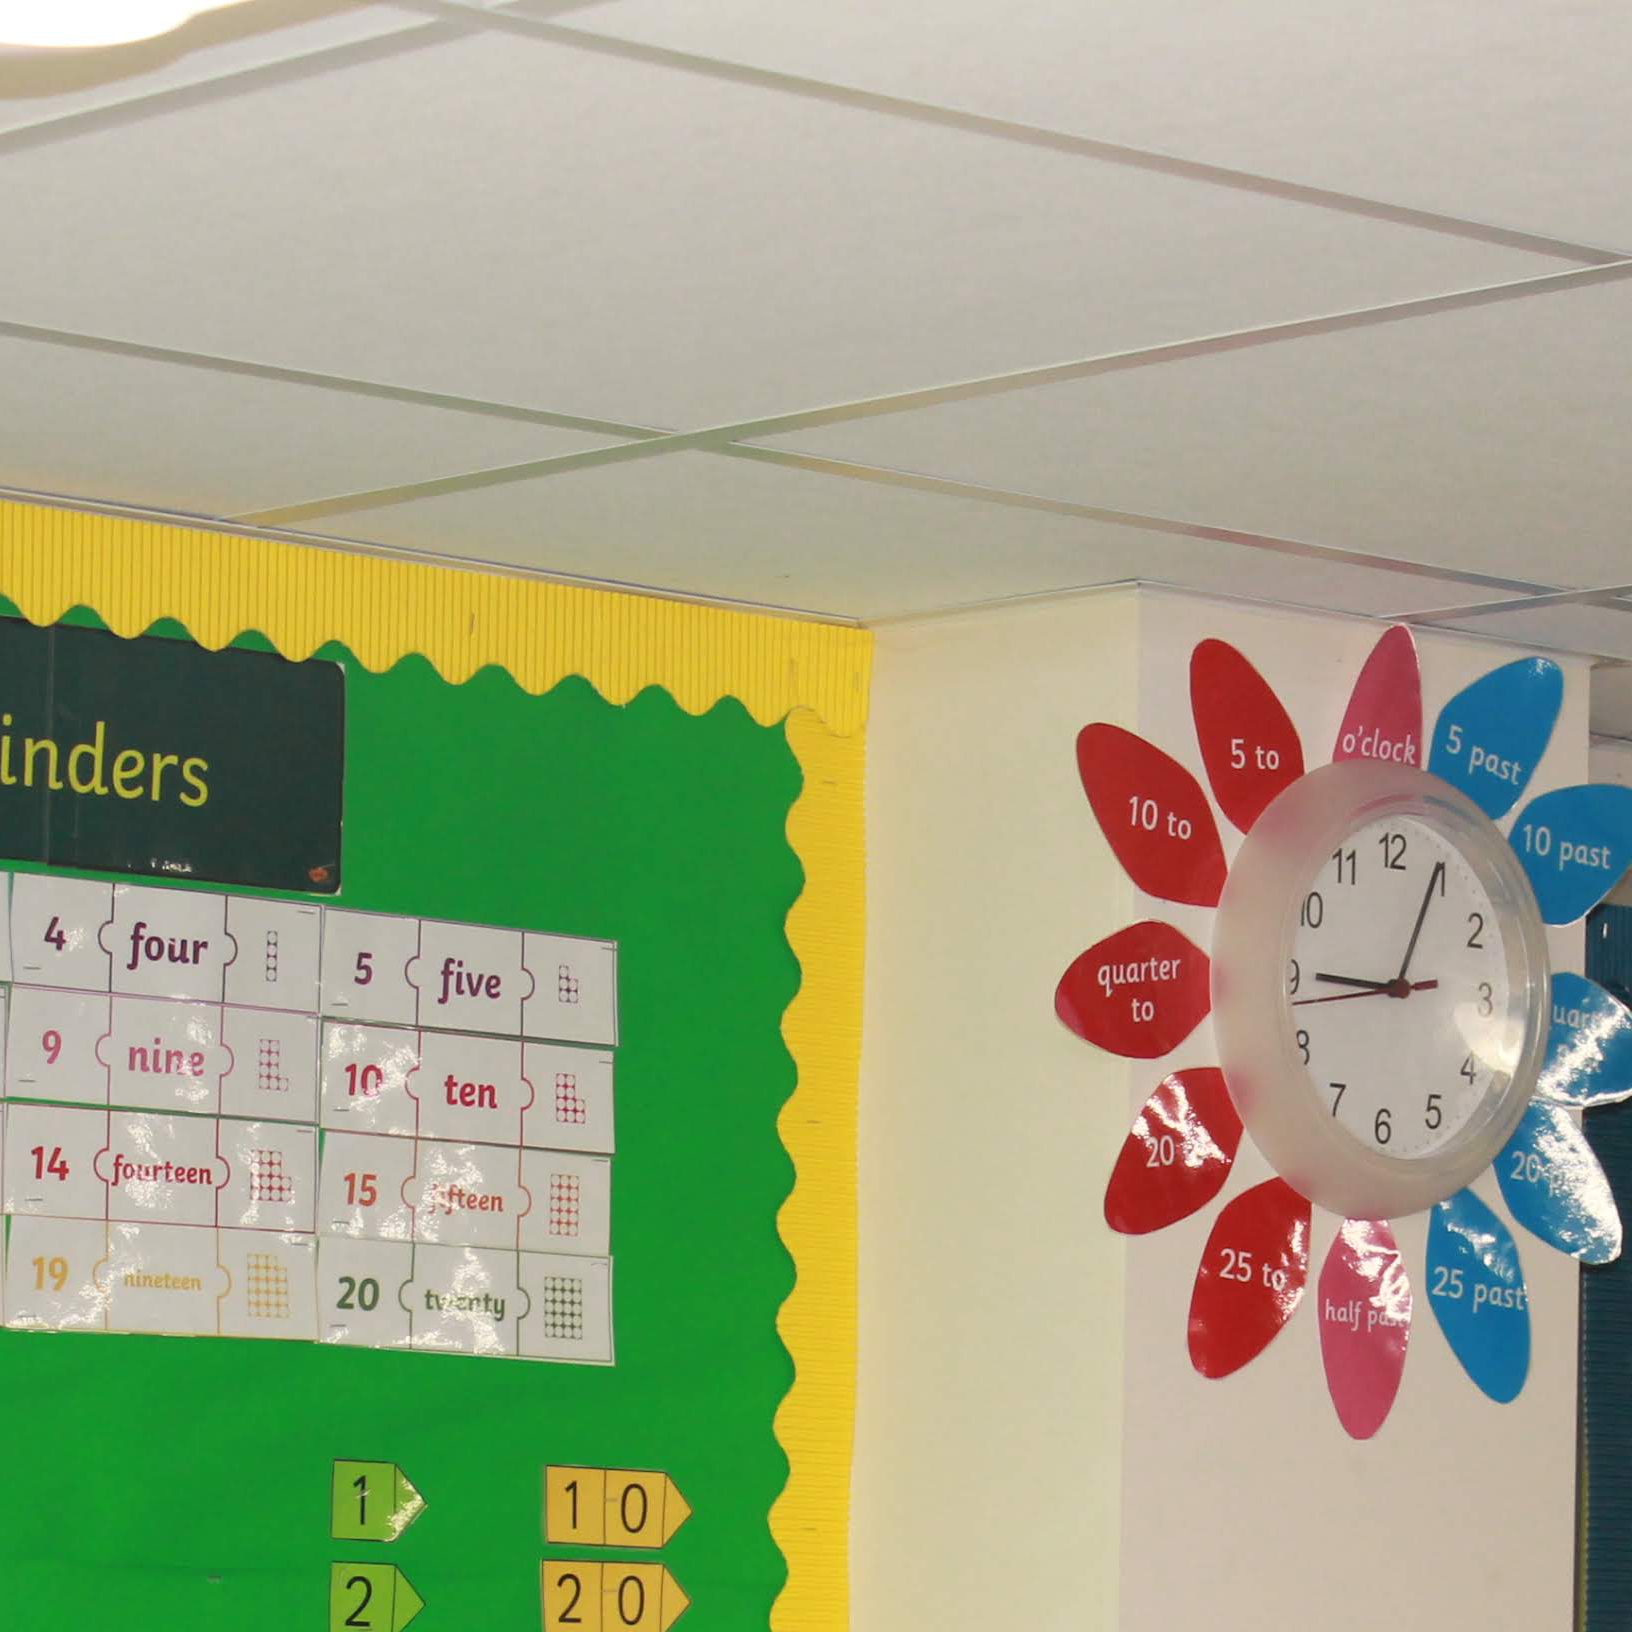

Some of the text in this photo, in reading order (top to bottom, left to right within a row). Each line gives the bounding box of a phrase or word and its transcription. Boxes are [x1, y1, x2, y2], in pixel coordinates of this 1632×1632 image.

[1231, 739, 1279, 770] 5 to
[1343, 727, 1415, 766] o'clock
[1446, 726, 1522, 787] 5 past
[1129, 796, 1192, 840] 10 to
[1379, 832, 1407, 870] 12
[1523, 824, 1611, 870] 10 past
[1332, 848, 1356, 885] 11
[44, 916, 208, 969] 4 four
[1468, 913, 1483, 949] 2
[355, 952, 501, 1003] 5 five
[1097, 957, 1180, 994] quarter
[1132, 997, 1154, 1022] to
[1478, 983, 1493, 1017] 3
[42, 1031, 205, 1078] 9 nine
[1461, 1051, 1477, 1084] 4
[344, 1064, 497, 1109] 10 ten
[1330, 1083, 1346, 1116] 7
[1375, 1108, 1391, 1144] 6
[1426, 1094, 1441, 1129] 5
[31, 1146, 211, 1186] 14 fourteen
[1146, 1135, 1175, 1168] 20
[1511, 1151, 1541, 1183] 20
[344, 1173, 377, 1206] 15
[32, 1257, 201, 1290] 19 nineteen
[1219, 1248, 1285, 1289] 25 to
[337, 1276, 379, 1310] 20
[1434, 1267, 1525, 1313] 25 past
[1326, 1299, 1362, 1331] half
[353, 1475, 366, 1525] 1
[345, 1576, 373, 1626] 2
